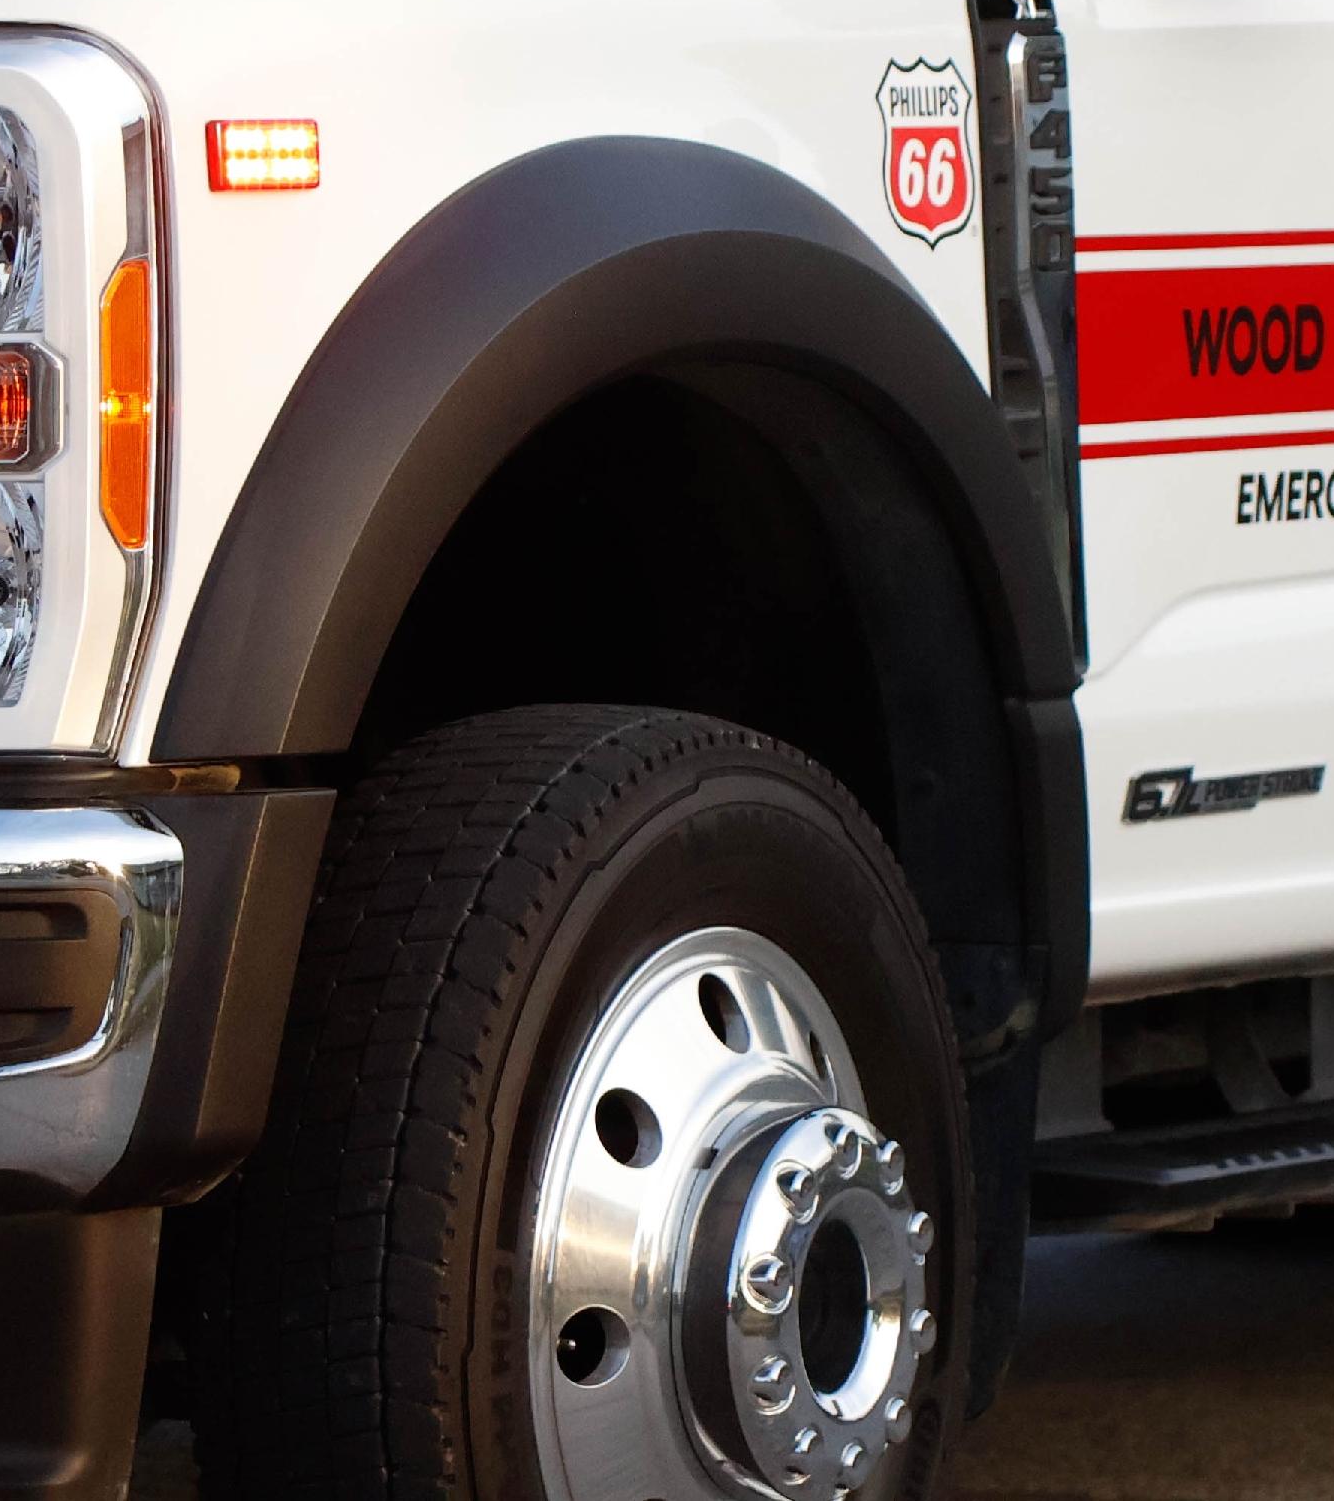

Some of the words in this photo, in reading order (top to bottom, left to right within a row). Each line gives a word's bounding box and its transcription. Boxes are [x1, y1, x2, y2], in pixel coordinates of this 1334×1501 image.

[890, 86, 960, 118] PHILLIPS
[898, 136, 957, 209] 66
[1183, 304, 1325, 377] WOOD
